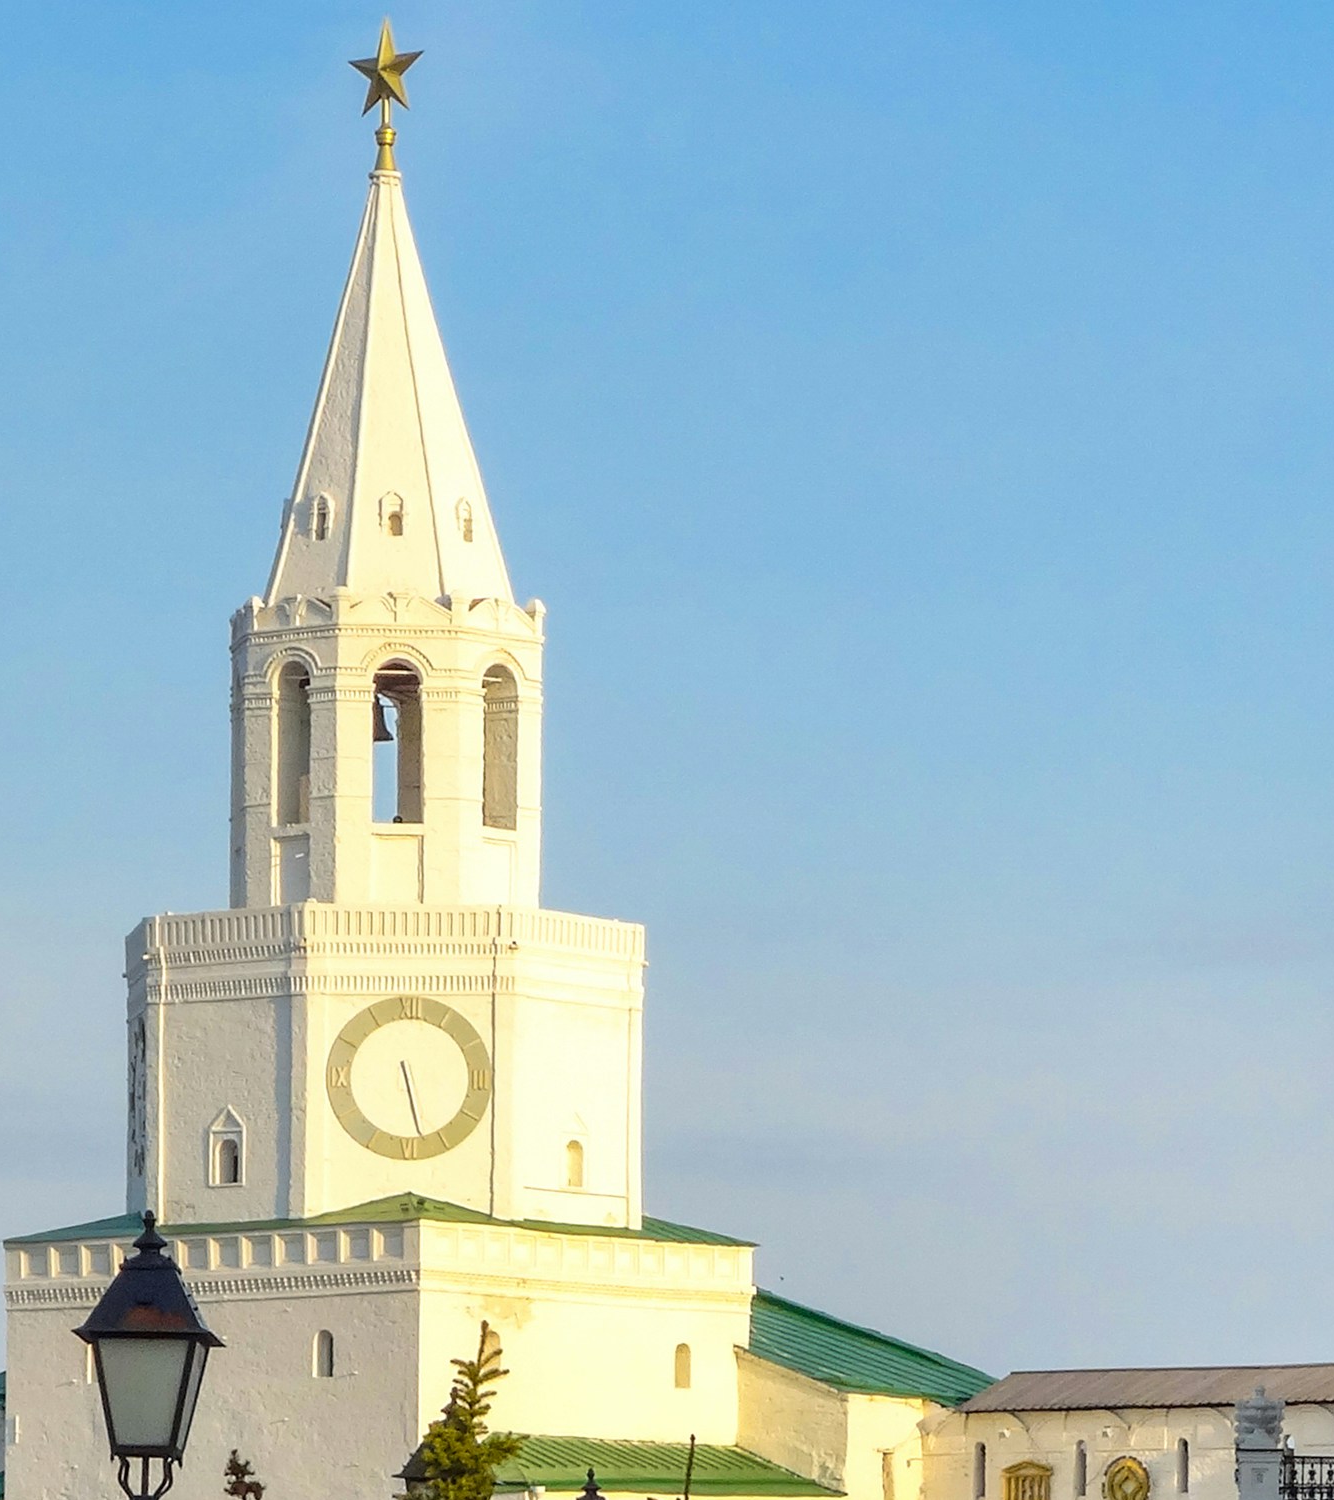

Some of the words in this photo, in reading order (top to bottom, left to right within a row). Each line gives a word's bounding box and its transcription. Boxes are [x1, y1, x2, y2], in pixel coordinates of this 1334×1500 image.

[399, 996, 421, 1020] XII
[330, 1066, 348, 1088] IX
[471, 1070, 489, 1091] III
[400, 1138, 418, 1160] VI
